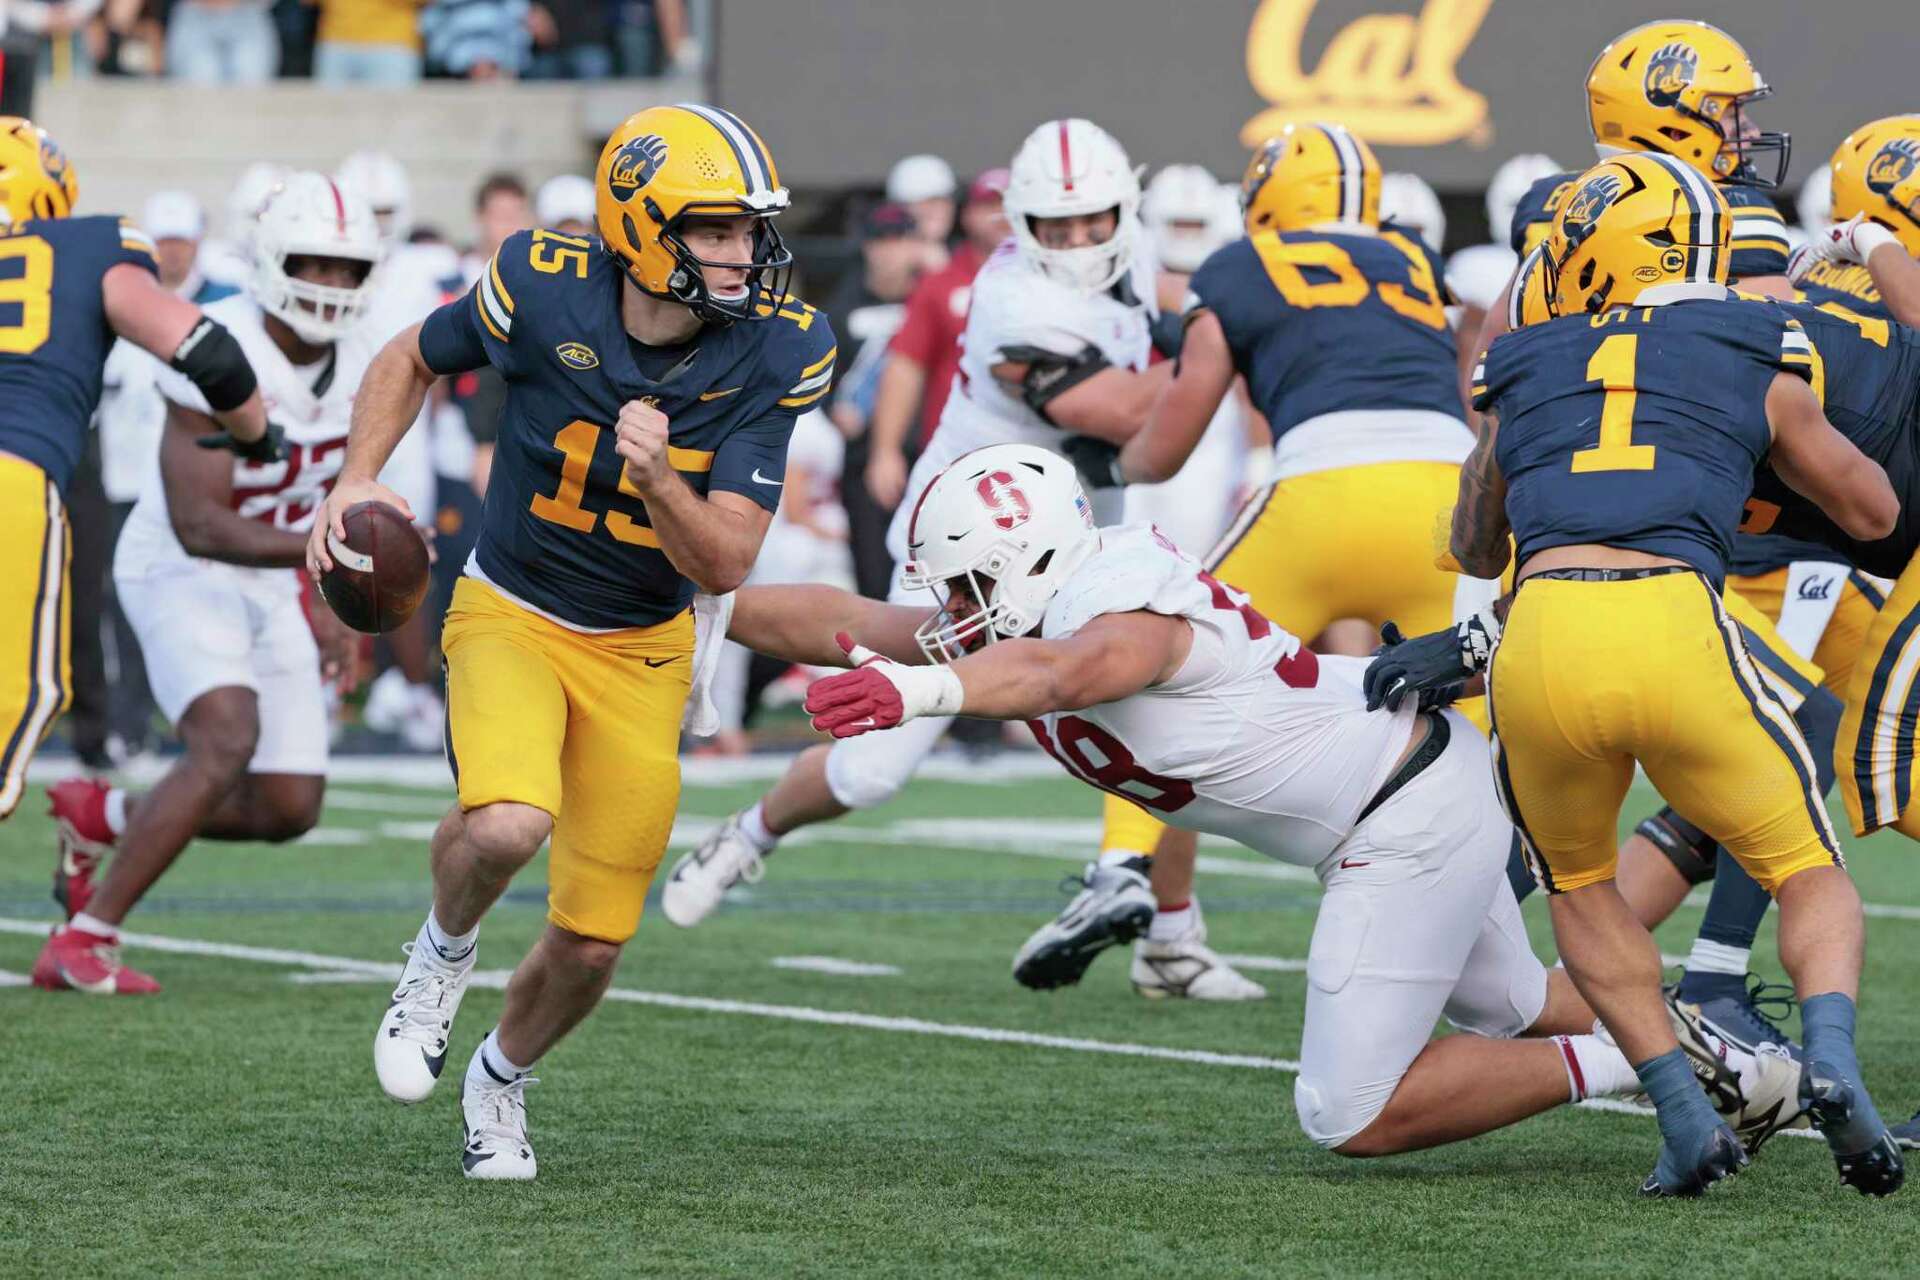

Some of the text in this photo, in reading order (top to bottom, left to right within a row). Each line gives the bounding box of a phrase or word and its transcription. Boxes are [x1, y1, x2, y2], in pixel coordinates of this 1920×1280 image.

[1239, 0, 1490, 147] Cal
[1647, 63, 1687, 94] Cal
[611, 154, 647, 188] Cal
[1871, 154, 1906, 183] Cal
[529, 228, 591, 279] 15
[1250, 227, 1448, 332] 63
[1571, 334, 1655, 473] 1
[530, 420, 715, 550] 15
[1796, 574, 1834, 602] Cal
